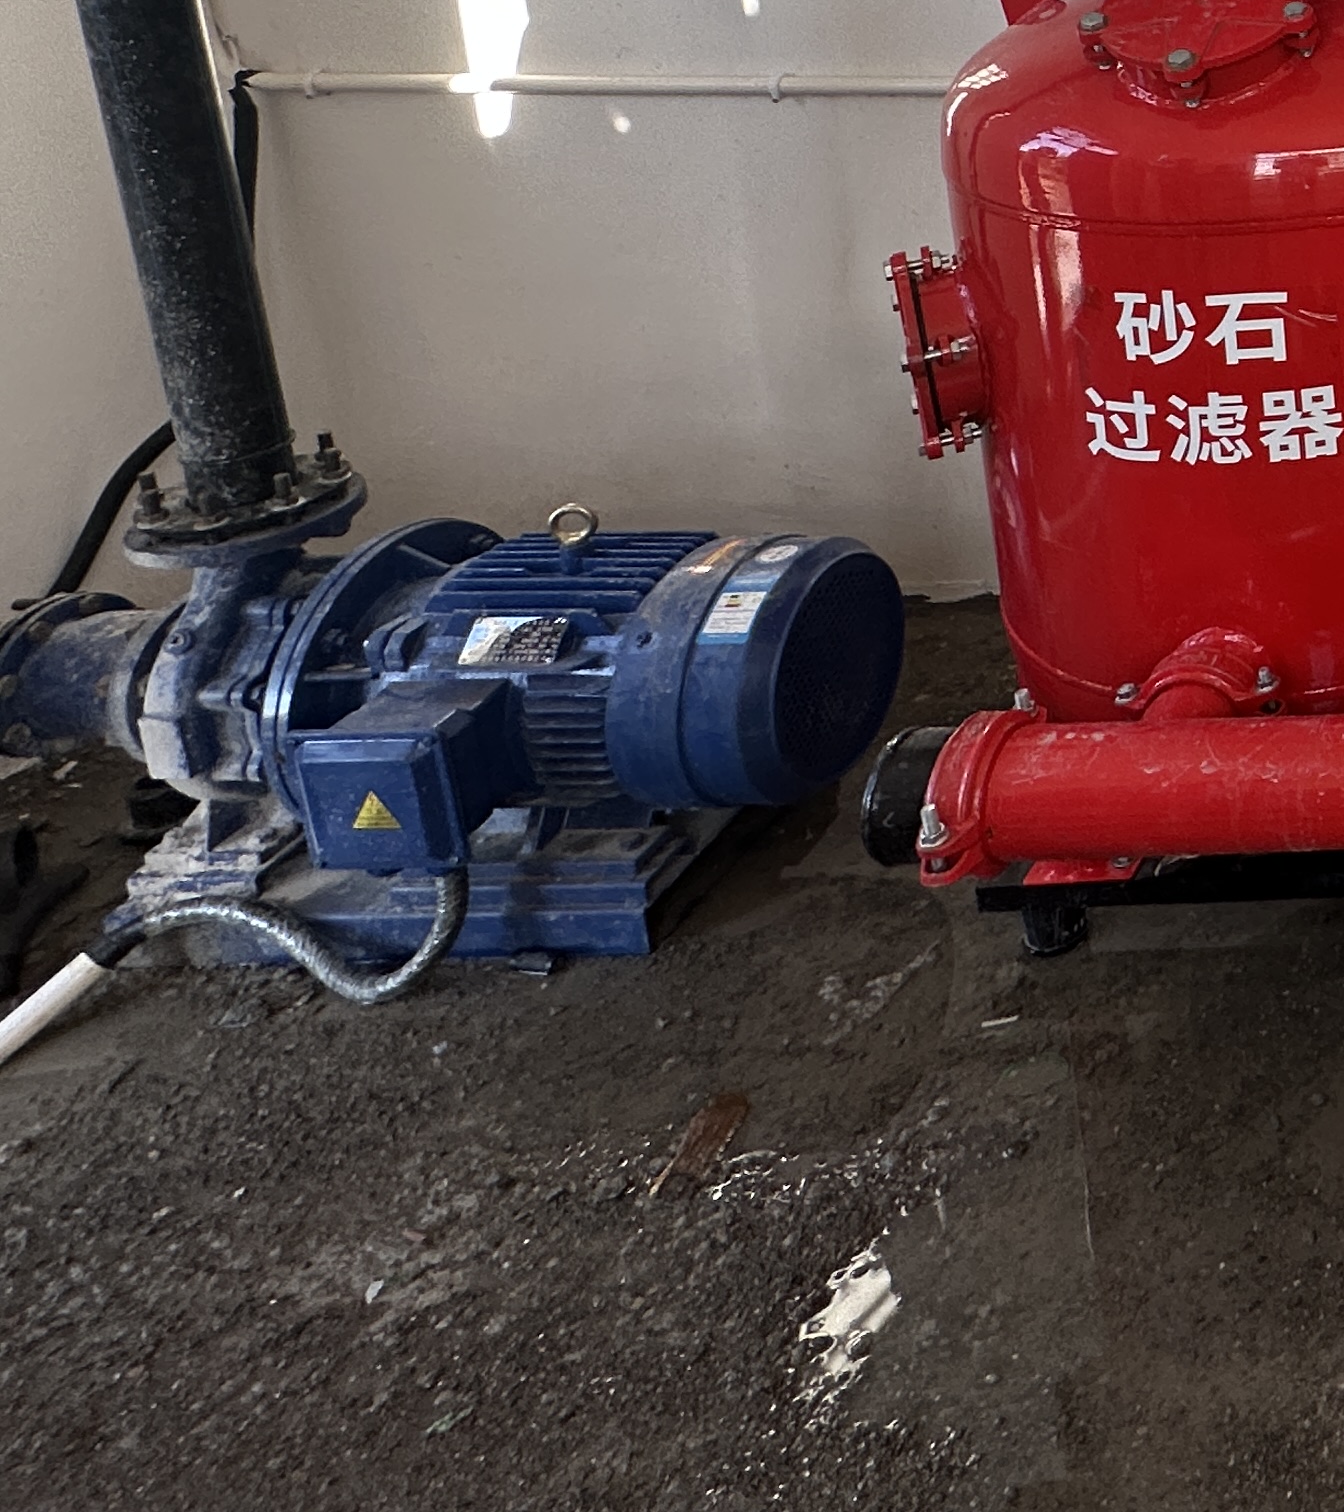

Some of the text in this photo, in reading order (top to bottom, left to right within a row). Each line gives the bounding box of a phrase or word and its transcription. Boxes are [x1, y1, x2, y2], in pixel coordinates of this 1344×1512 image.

[1114, 289, 1288, 365] 砂石
[1084, 385, 1344, 466] 过滤器
